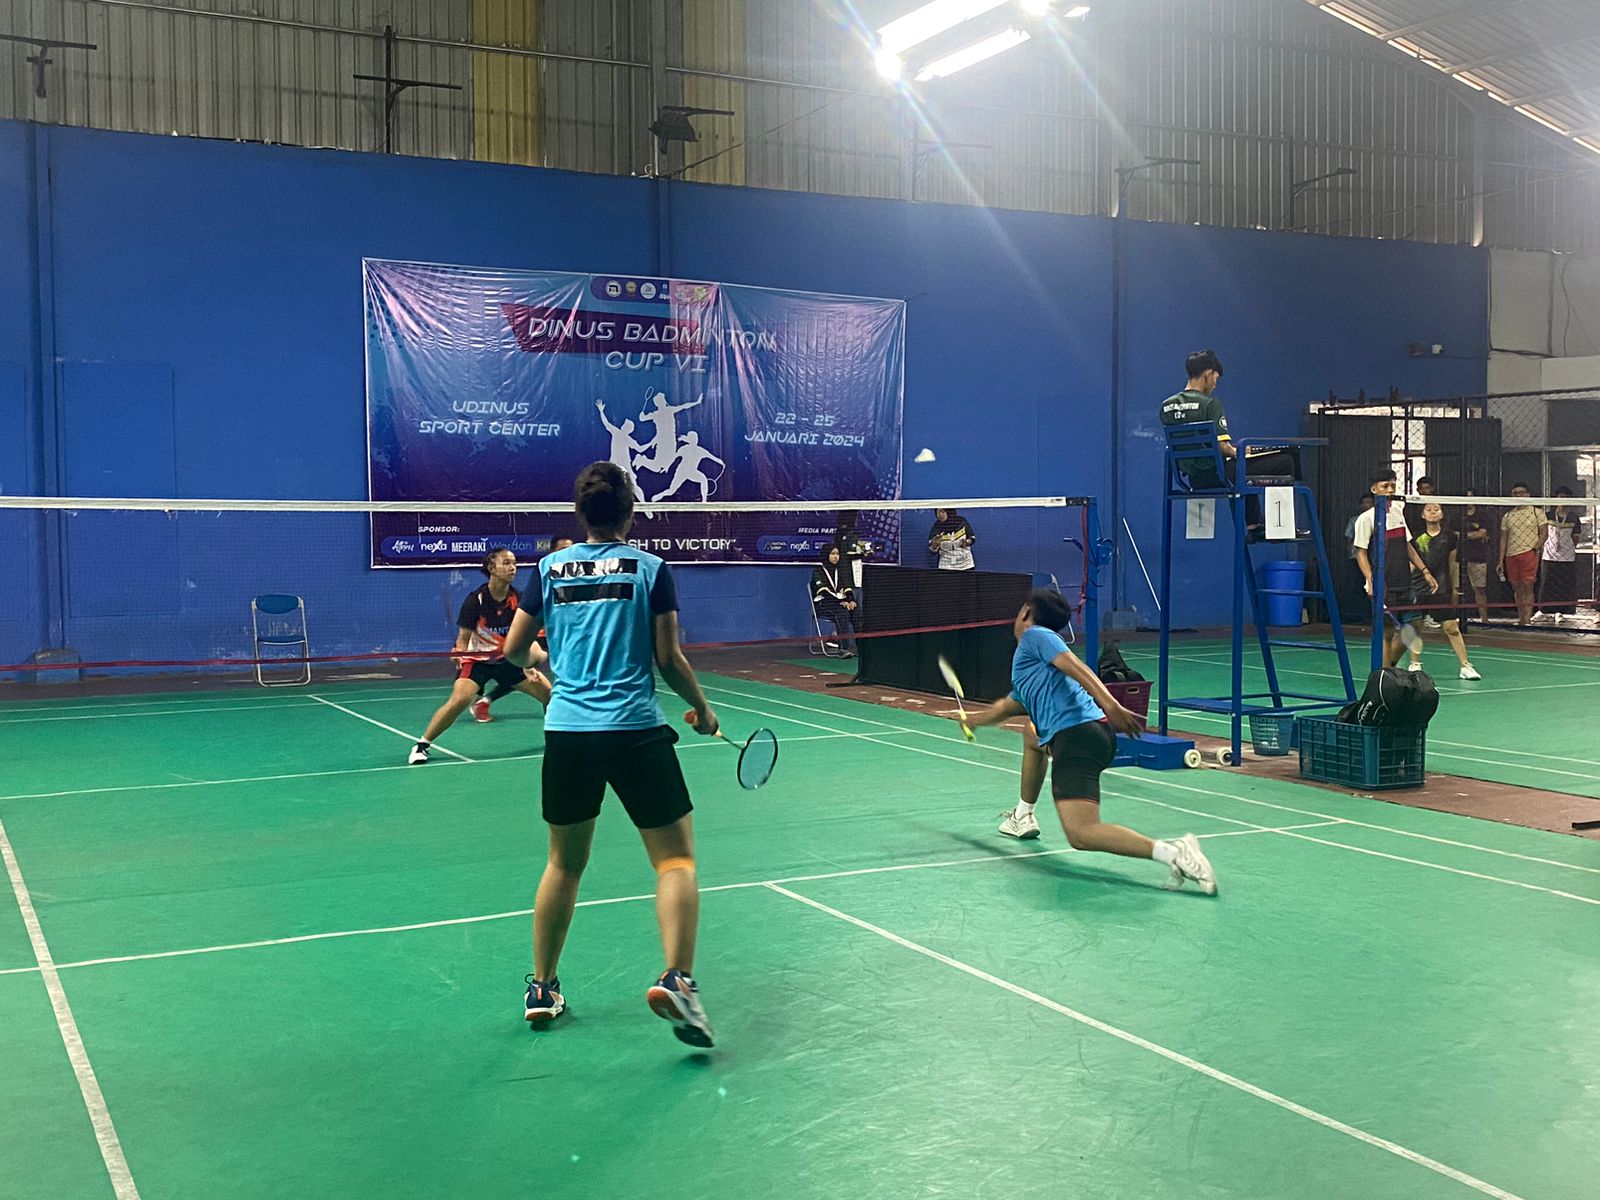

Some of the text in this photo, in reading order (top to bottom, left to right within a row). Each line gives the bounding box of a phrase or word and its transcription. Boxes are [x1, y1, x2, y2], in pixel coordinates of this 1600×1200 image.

[528, 318, 777, 350] DINUS BADMINTON
[605, 350, 710, 374] CUP VI
[452, 400, 530, 415] UDINUS
[775, 412, 796, 425] 22
[814, 414, 836, 427] 25
[419, 420, 561, 437] SPORT CENTER
[744, 430, 865, 447] JANUARI 2024
[1194, 502, 1205, 528] 1
[1273, 500, 1283, 528] 1
[451, 538, 489, 552] MEERAKI
[651, 539, 671, 550] TO
